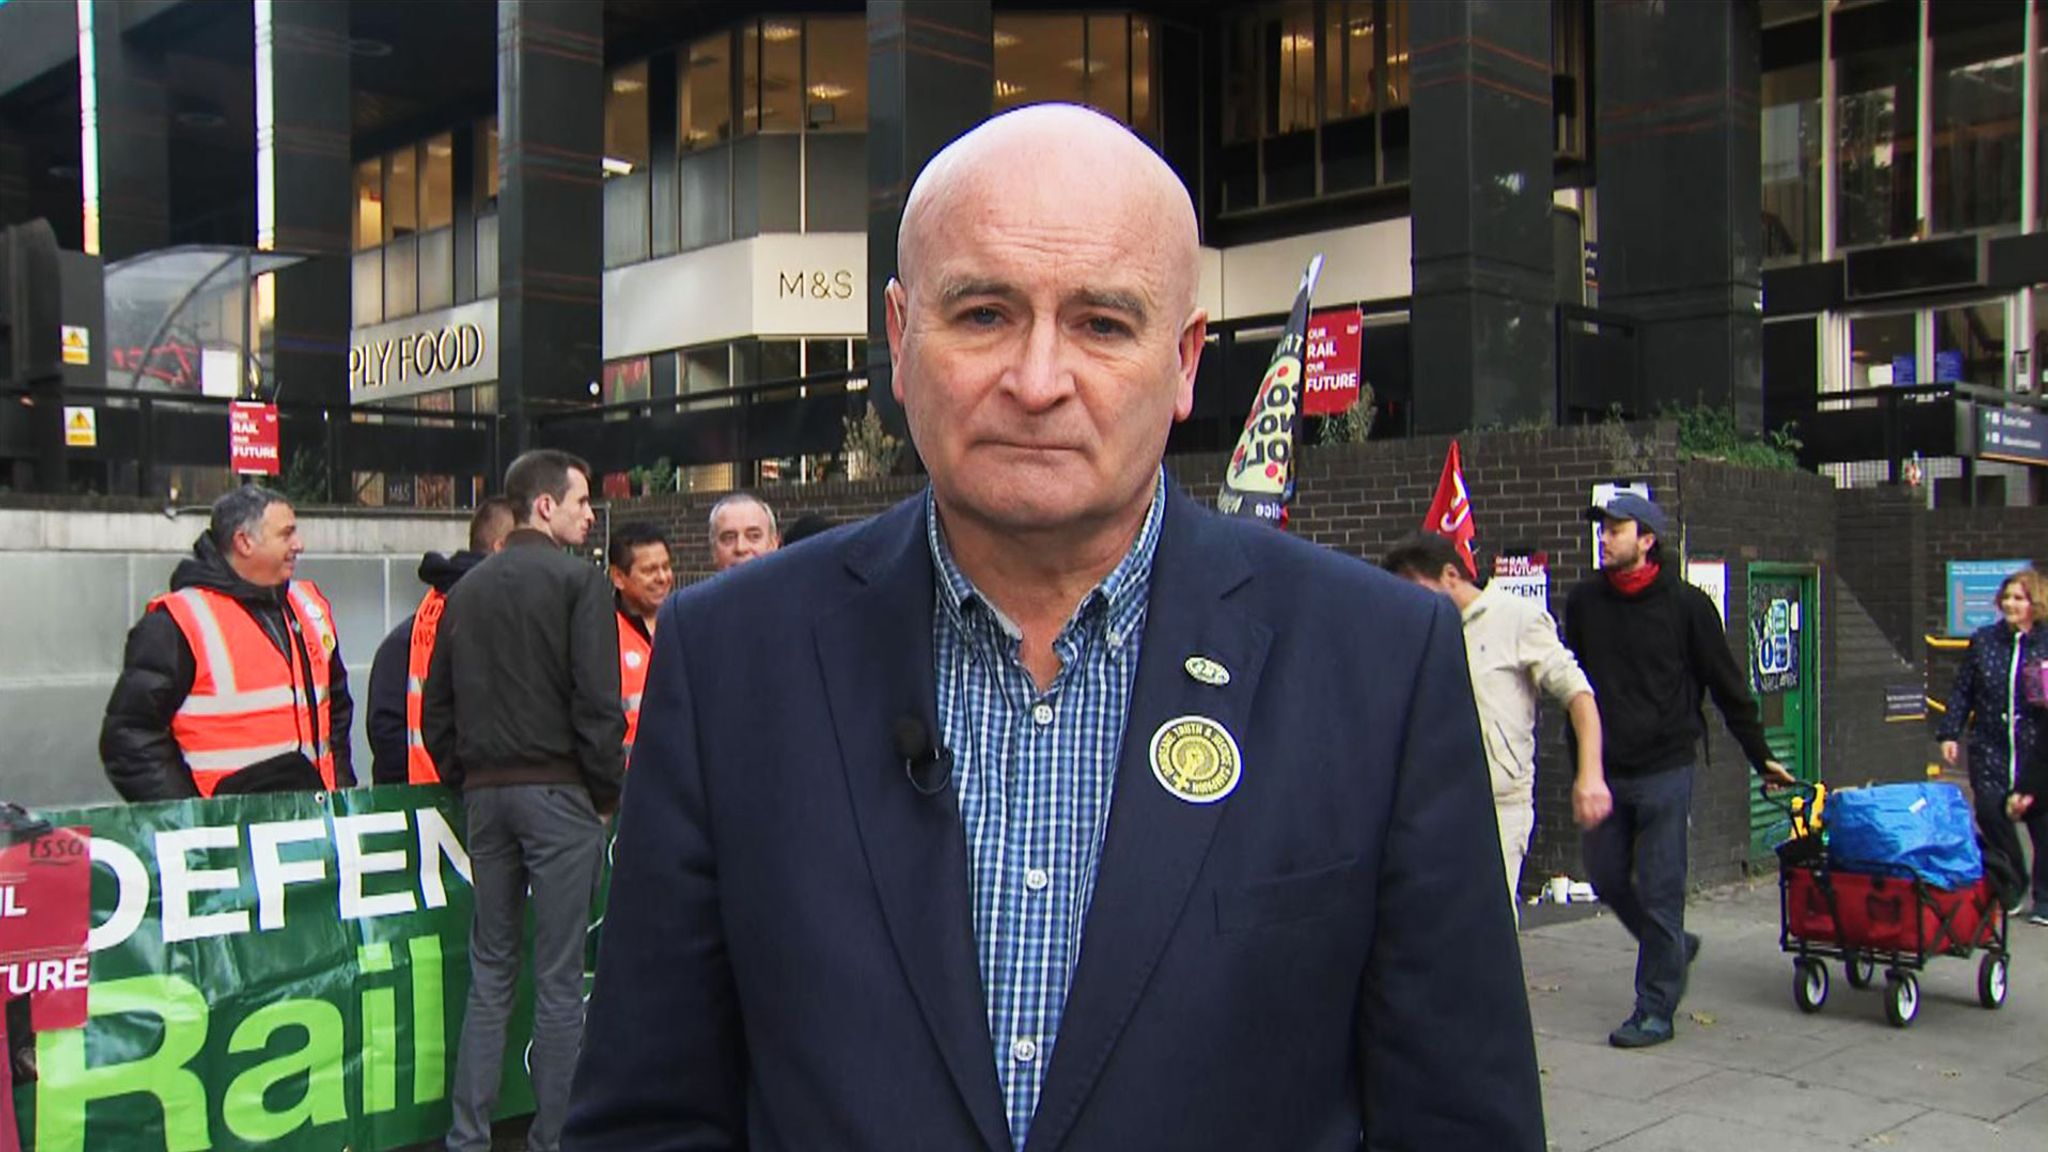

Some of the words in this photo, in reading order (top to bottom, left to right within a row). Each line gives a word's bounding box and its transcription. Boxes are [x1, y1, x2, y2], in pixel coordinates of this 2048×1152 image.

[780, 269, 852, 299] M&S
[1308, 328, 1327, 339] OUR
[399, 322, 484, 381] FOOD
[1307, 341, 1337, 359] RAIL
[1306, 361, 1325, 373] OUR
[1306, 372, 1357, 393] FUTURE
[232, 421, 260, 434] RAIL
[232, 446, 278, 458] FUTURE
[36, 933, 446, 1152] Rail
